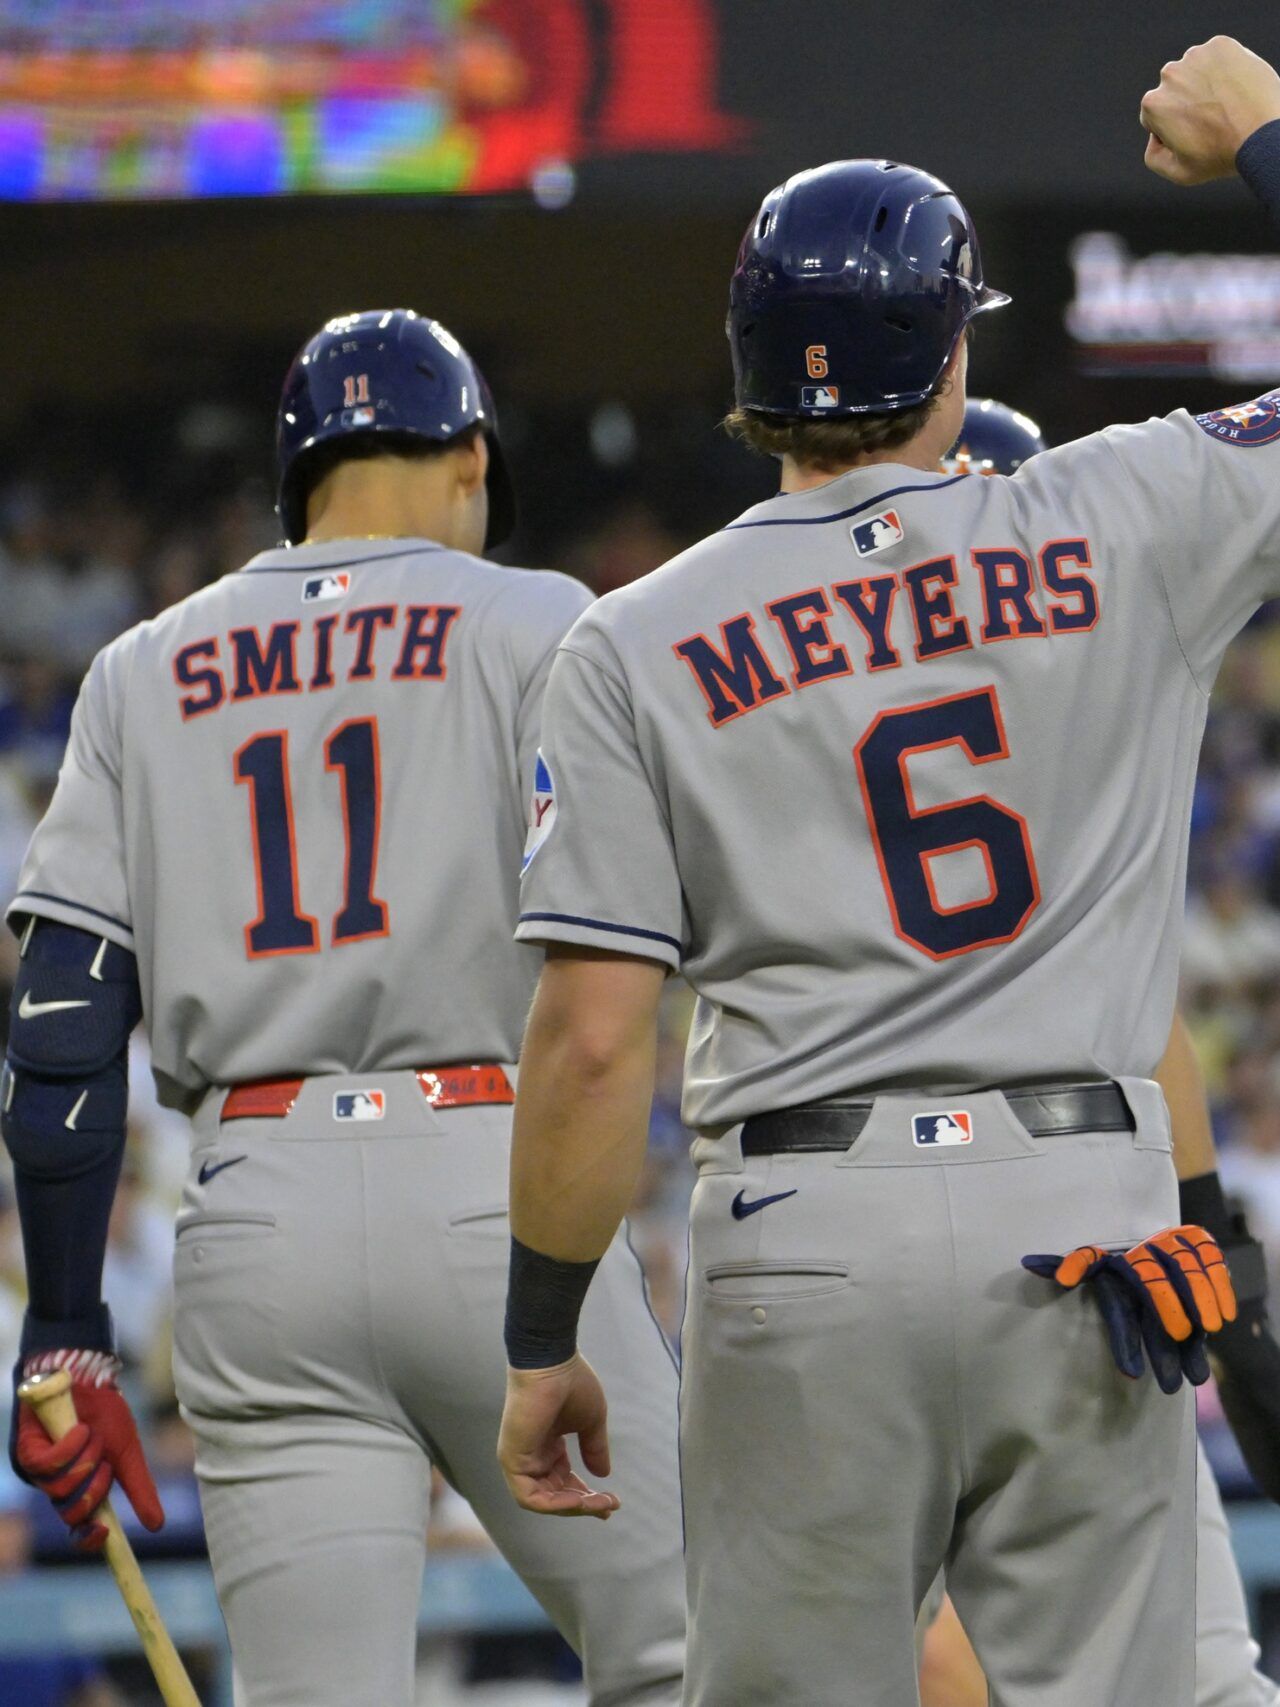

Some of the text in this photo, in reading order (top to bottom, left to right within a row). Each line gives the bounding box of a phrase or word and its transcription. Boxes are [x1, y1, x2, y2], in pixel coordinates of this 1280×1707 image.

[343, 374, 370, 408] 11
[805, 345, 829, 379] 6
[172, 604, 462, 723] SMITH
[672, 537, 1100, 729] MEYERS
[232, 715, 390, 962] 11
[852, 684, 1042, 962] 6
